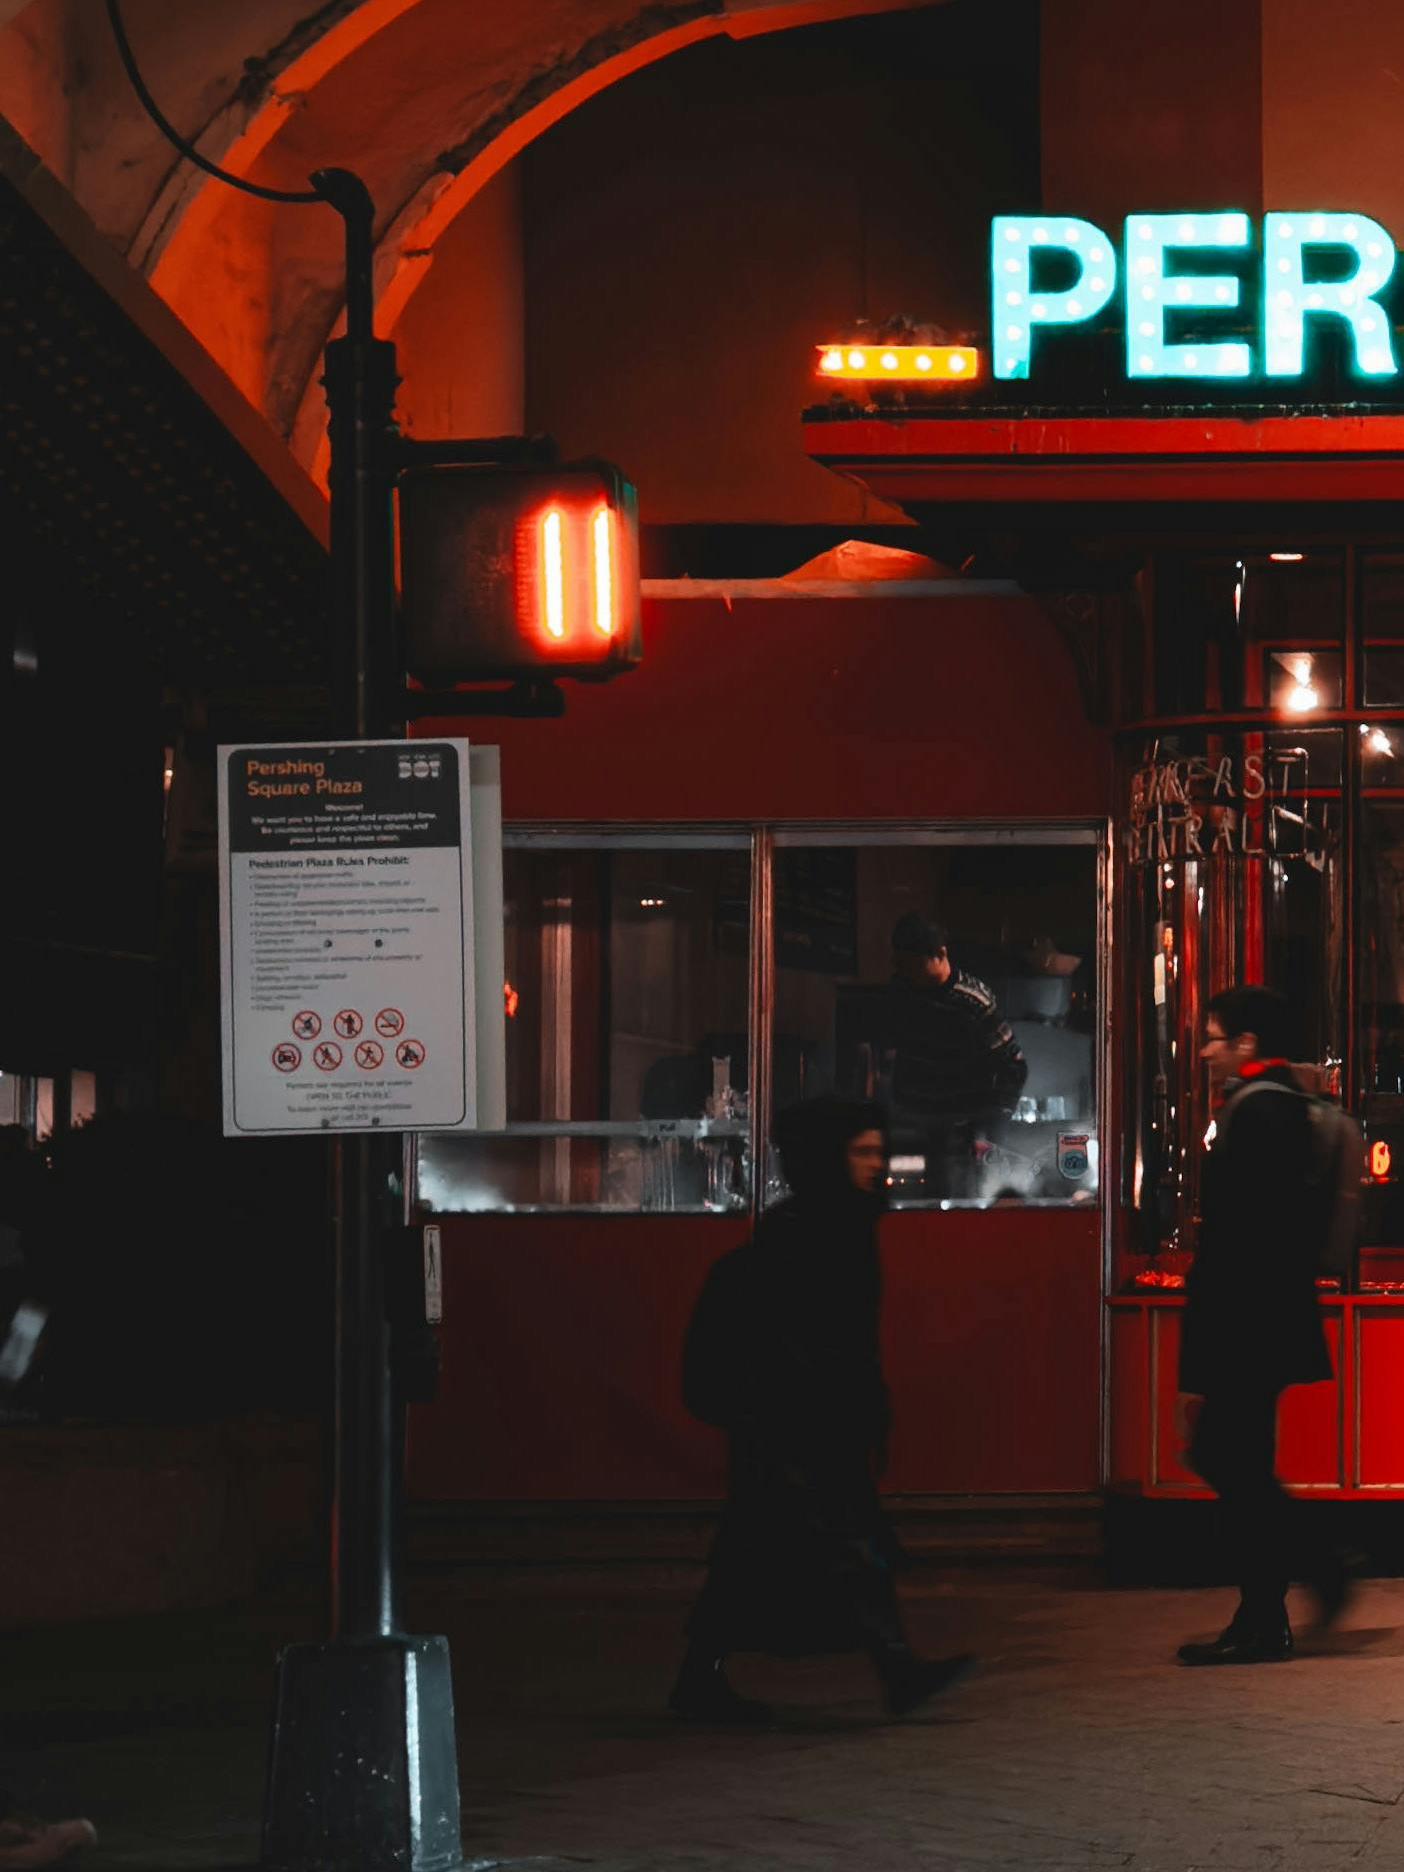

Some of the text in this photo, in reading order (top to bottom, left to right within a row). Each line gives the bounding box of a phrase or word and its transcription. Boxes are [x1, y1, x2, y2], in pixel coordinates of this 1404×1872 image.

[247, 759, 325, 777] Pershing
[247, 779, 363, 798] Square Plaza
[249, 858, 303, 869] Pedestrian
[306, 857, 333, 867] Plaza
